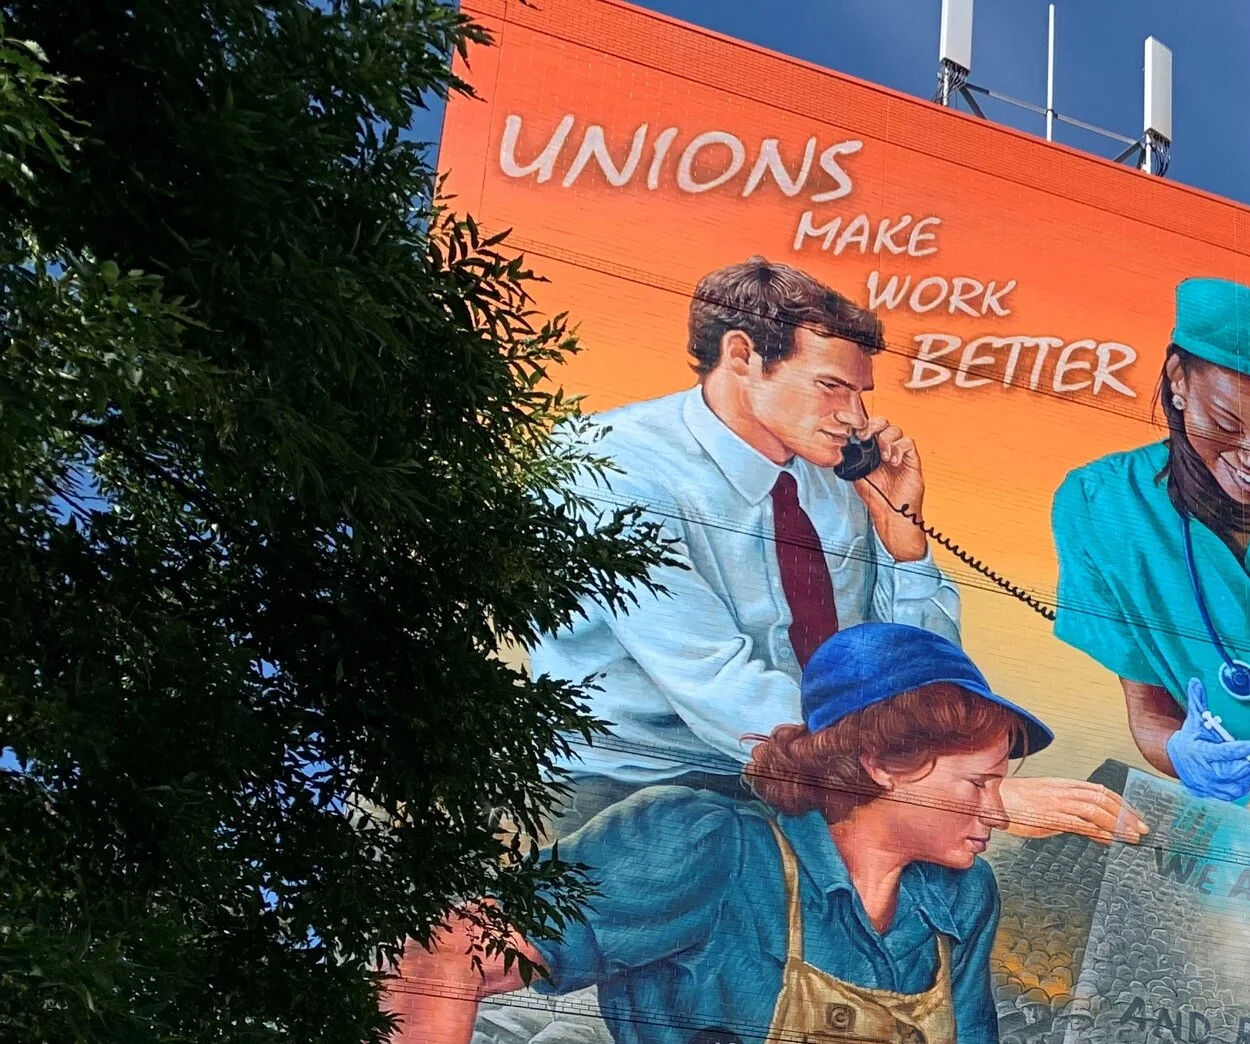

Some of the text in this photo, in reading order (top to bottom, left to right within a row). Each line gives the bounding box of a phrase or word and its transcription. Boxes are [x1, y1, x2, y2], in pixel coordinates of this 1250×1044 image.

[500, 113, 863, 202] UNIONS
[793, 211, 941, 256] MAKE
[865, 270, 1018, 317] WORK
[905, 332, 1137, 398] BETTER
[1154, 848, 1219, 895] WE
